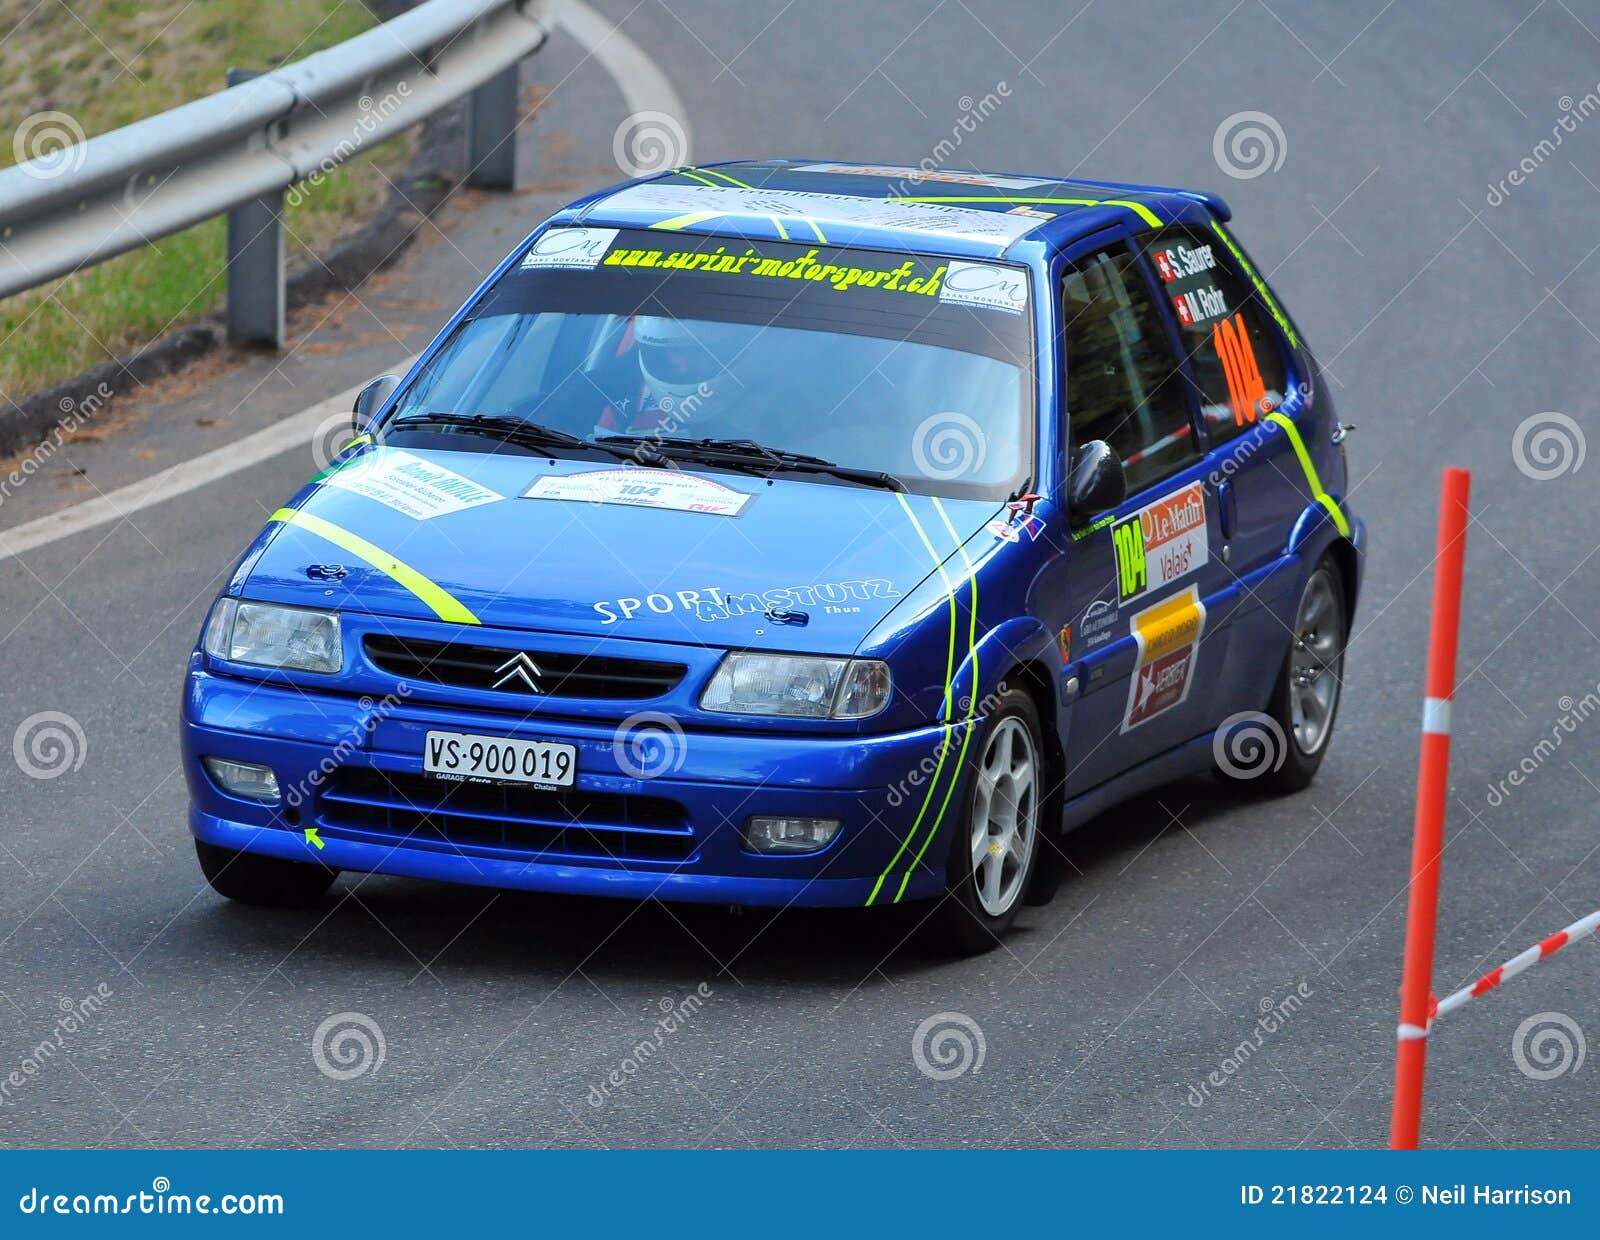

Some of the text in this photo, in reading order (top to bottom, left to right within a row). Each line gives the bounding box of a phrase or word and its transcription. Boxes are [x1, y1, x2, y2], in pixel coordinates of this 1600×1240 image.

[1166, 244, 1217, 279] S. Saurer
[1184, 285, 1228, 323] M. Rohr
[1213, 312, 1272, 427] 104
[619, 484, 662, 497] 104
[1153, 513, 1169, 540] Le
[1168, 495, 1202, 531] Matin
[1114, 518, 1148, 598] 104
[1160, 550, 1190, 582] Valais
[592, 587, 721, 625] SPORT
[696, 578, 900, 622] AMSTUTZ
[823, 605, 861, 613] Thun
[436, 772, 465, 782] GARAGE
